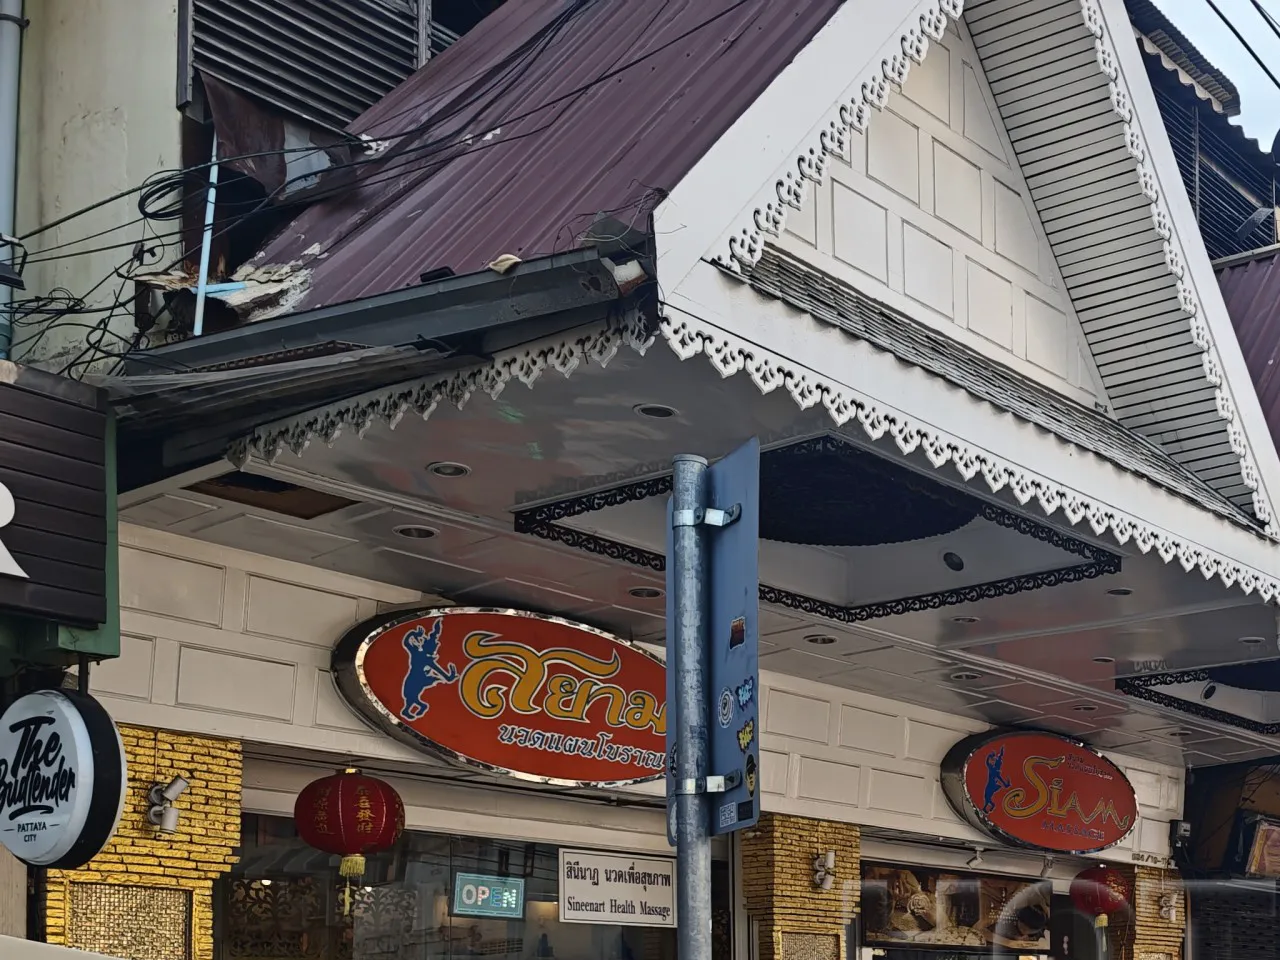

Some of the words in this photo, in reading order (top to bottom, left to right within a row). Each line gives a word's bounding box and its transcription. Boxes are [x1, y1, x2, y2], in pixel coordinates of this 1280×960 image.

[9, 716, 62, 778] The
[17, 821, 47, 832] PATTAYA
[24, 834, 37, 842] CITY
[604, 862, 671, 891] นวดเพื่อสุขภาพ
[462, 884, 517, 909] OPEN
[567, 897, 605, 913] Sineenart
[609, 898, 636, 915] Health
[640, 900, 671, 921] Massage
